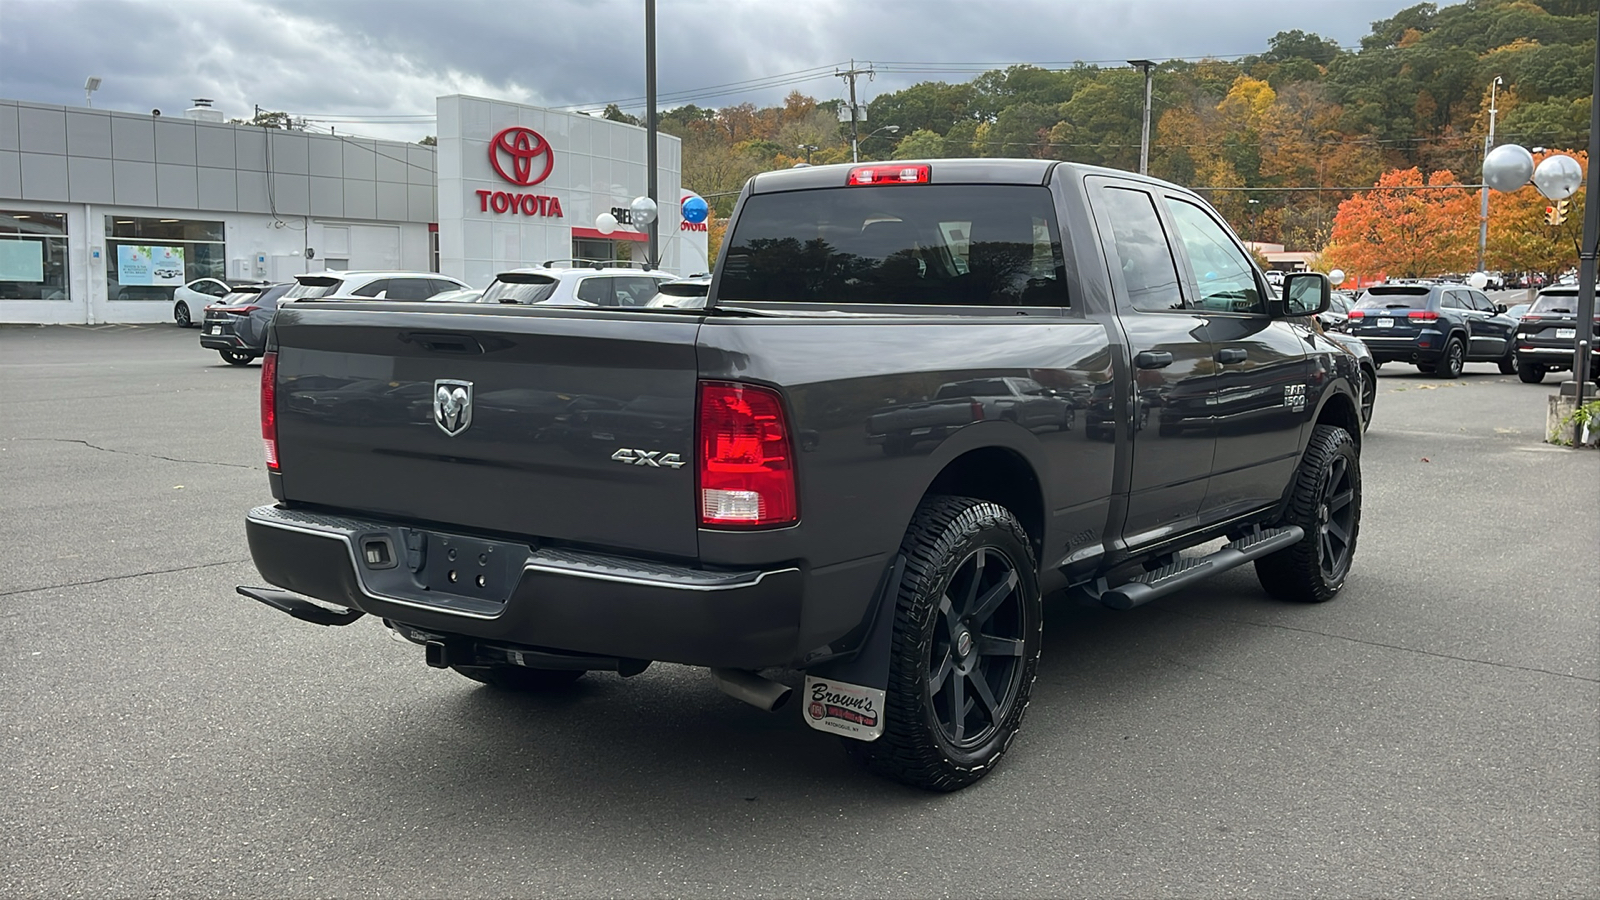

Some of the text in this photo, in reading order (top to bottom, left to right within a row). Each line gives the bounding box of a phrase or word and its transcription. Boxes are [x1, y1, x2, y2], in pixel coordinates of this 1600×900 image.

[476, 190, 564, 218] TOYOTA
[681, 221, 707, 232] OYOTA
[1284, 395, 1305, 407] 1500
[811, 683, 874, 712] Brown's
